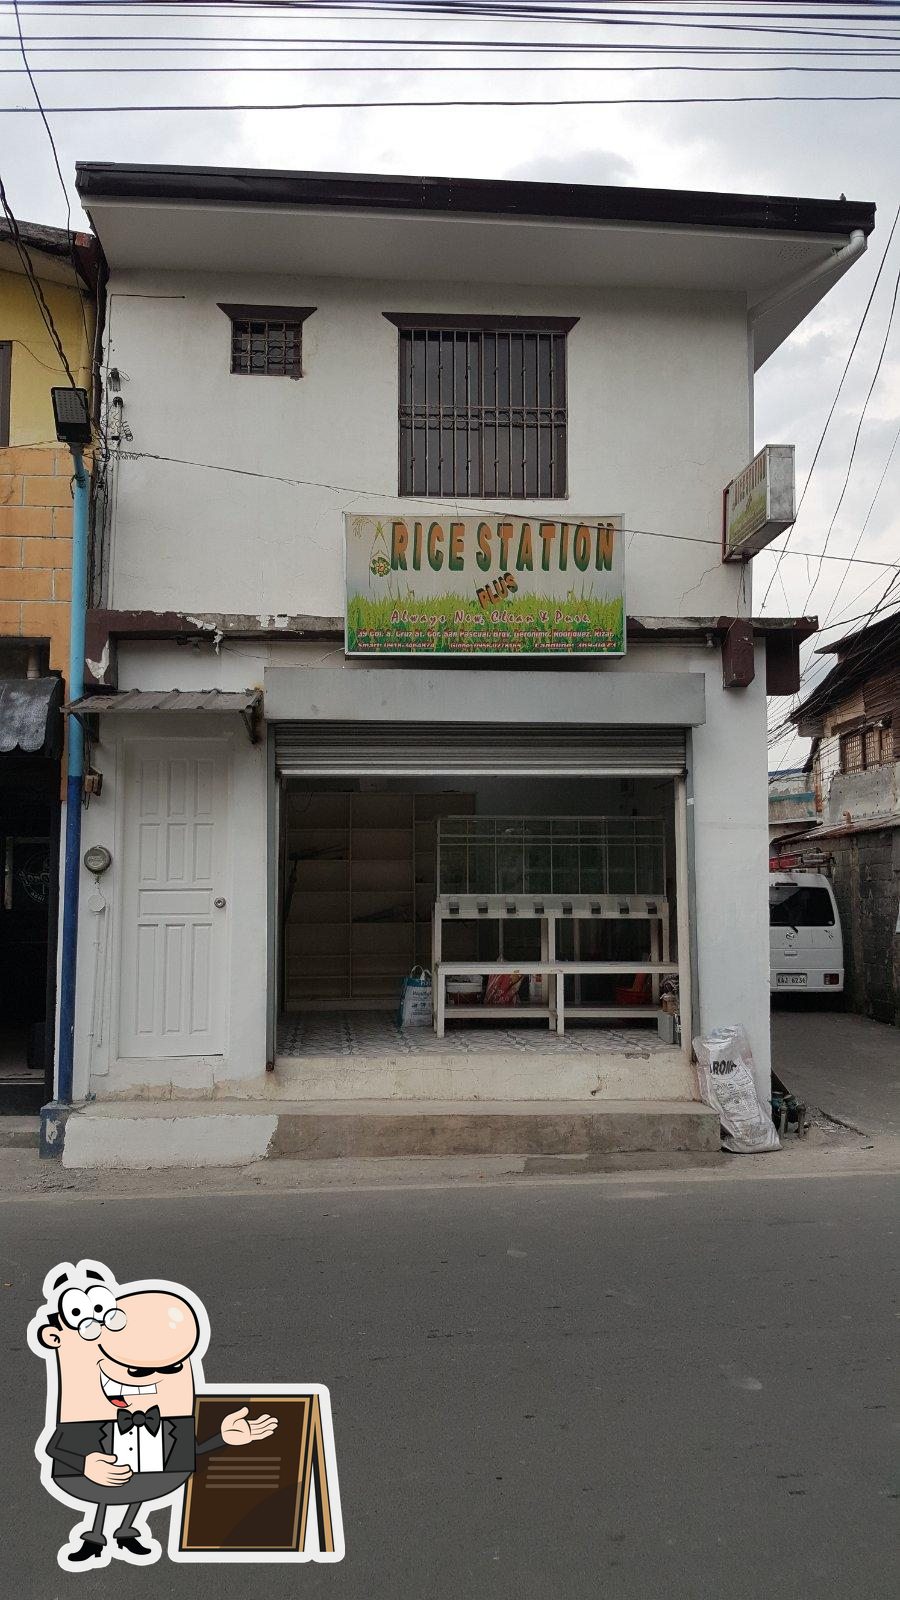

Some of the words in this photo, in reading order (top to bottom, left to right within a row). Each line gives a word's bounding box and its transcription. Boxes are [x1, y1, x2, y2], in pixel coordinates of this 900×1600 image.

[390, 521, 466, 572] RICE
[475, 521, 615, 572] STATION
[476, 572, 519, 610] PLUS
[390, 609, 447, 626] Always
[490, 609, 534, 623] Clean
